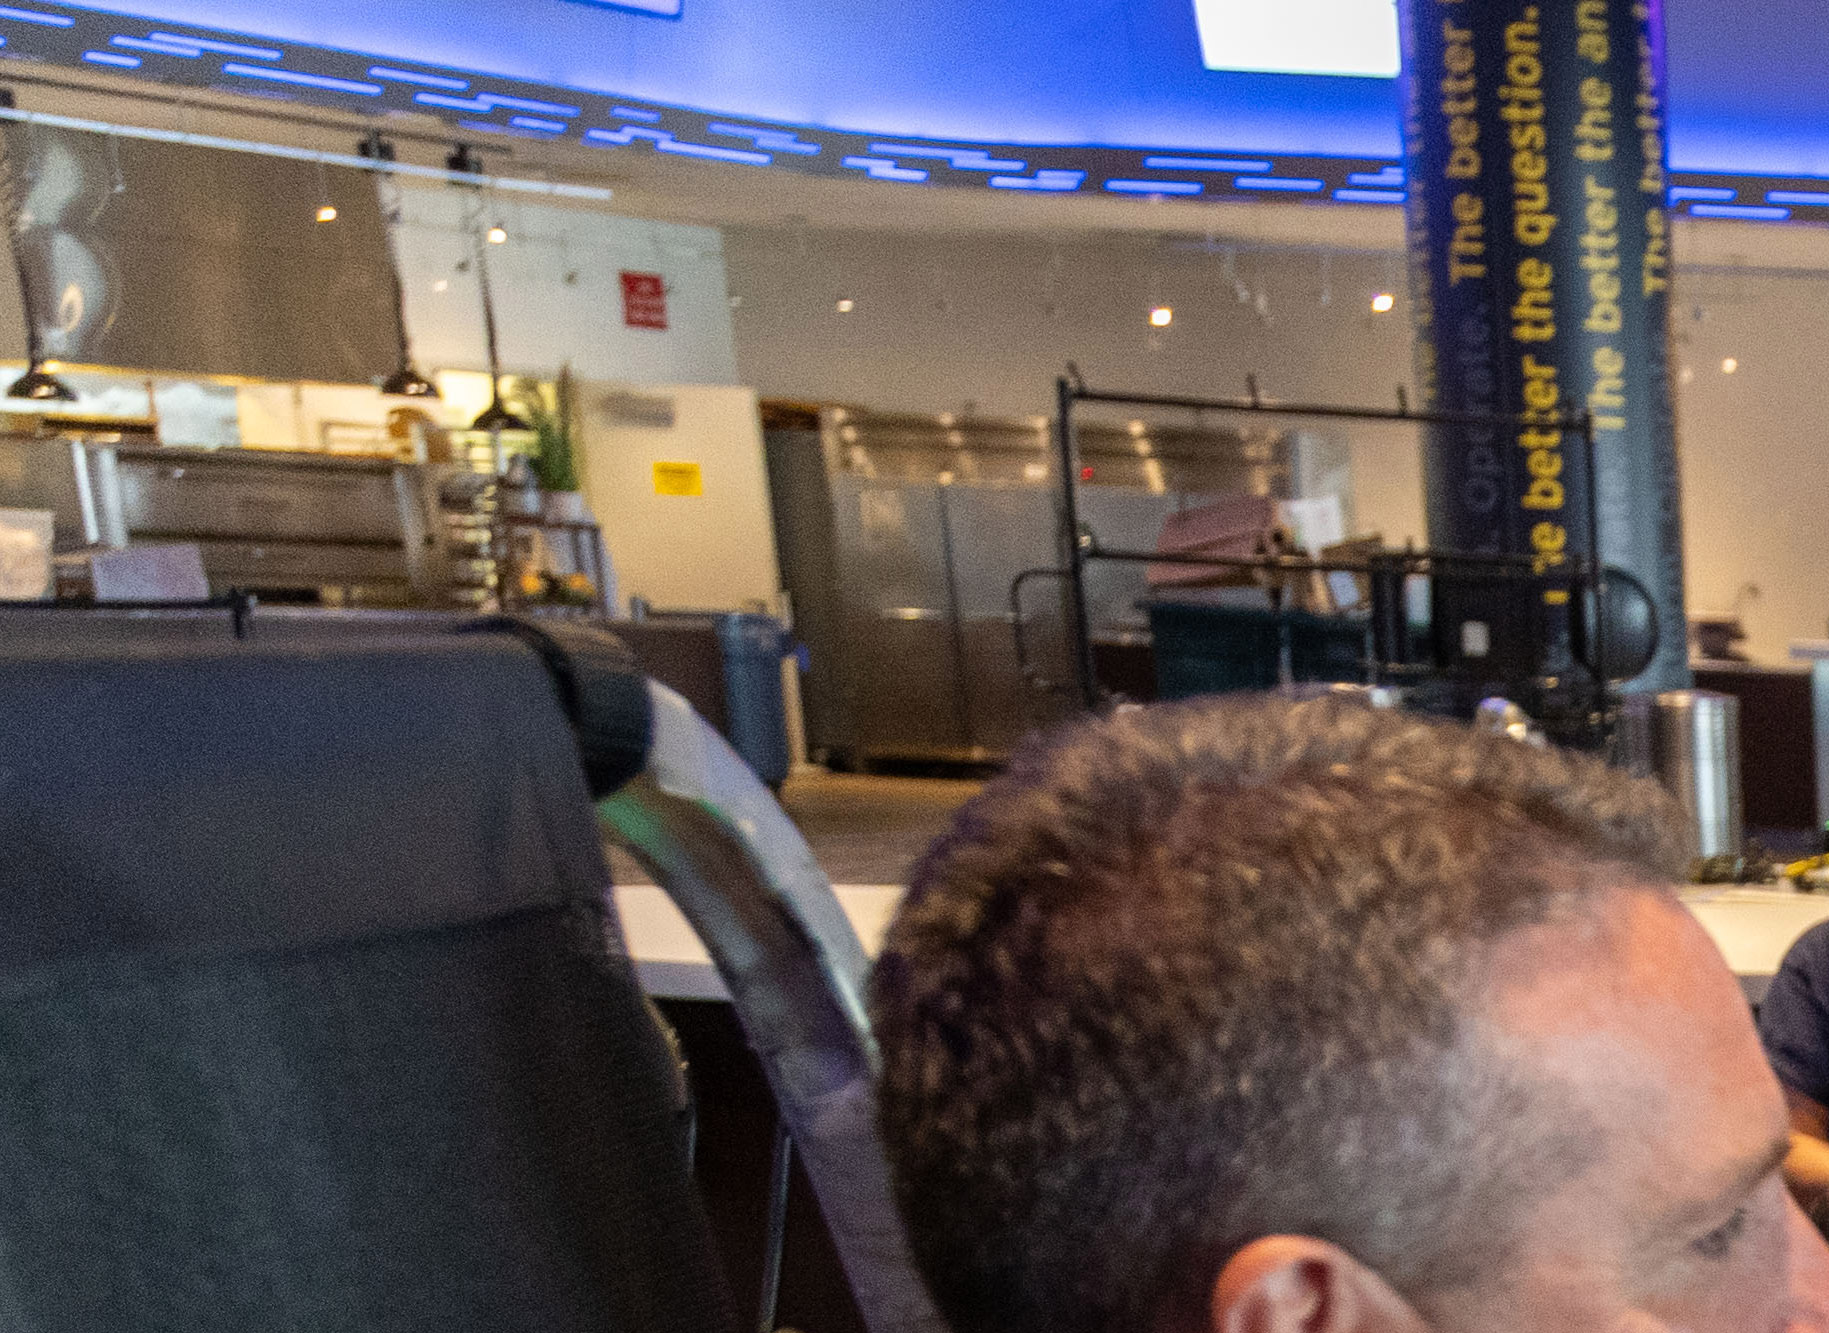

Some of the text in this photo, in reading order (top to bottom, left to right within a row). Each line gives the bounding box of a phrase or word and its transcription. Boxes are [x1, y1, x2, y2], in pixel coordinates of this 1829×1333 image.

[1441, 18, 1486, 285] The better
[1499, 5, 1560, 246] question.
[1574, 77, 1614, 161] the
[1512, 258, 1555, 342] the
[1578, 174, 1623, 333] better
[1518, 354, 1565, 510] better
[1586, 346, 1627, 441] The
